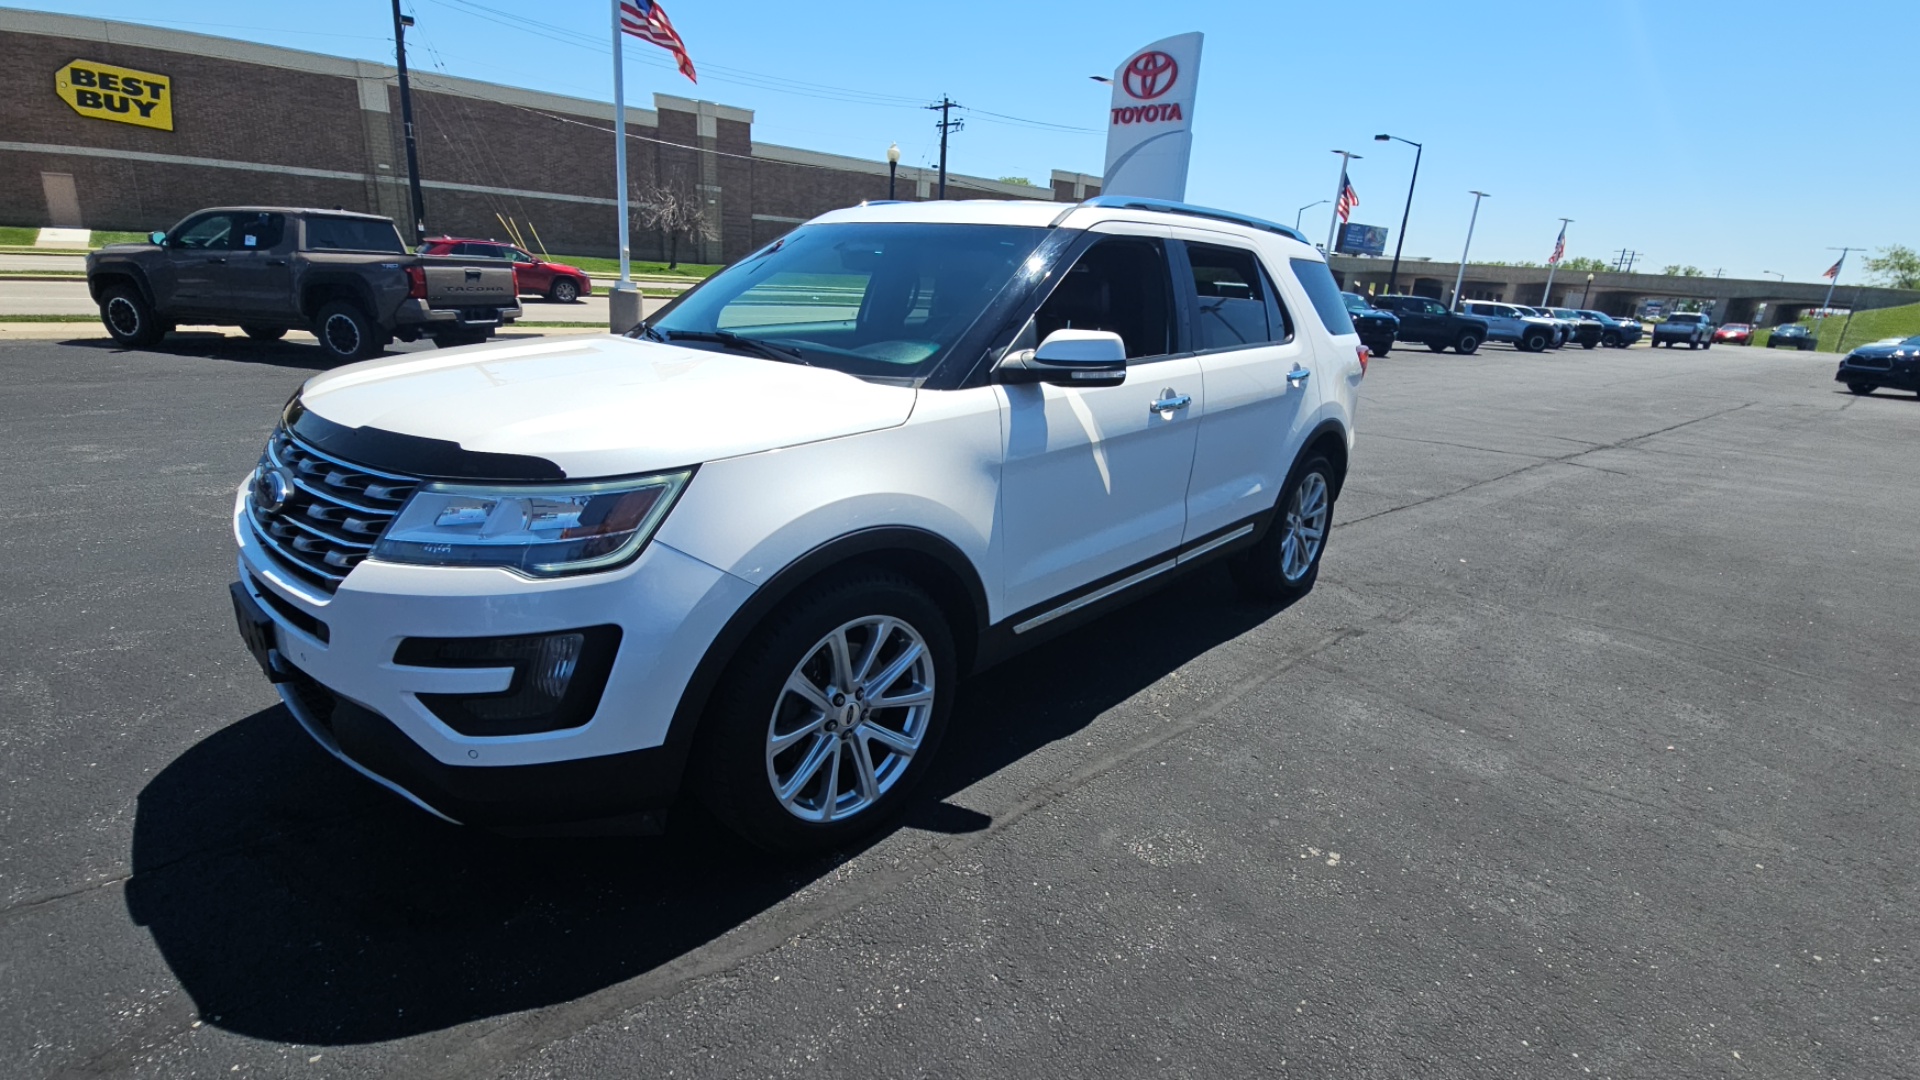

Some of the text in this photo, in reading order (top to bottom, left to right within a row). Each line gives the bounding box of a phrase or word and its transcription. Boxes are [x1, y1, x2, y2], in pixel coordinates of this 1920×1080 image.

[70, 67, 165, 100] BEST
[76, 89, 158, 118] BUY
[1111, 103, 1182, 125] TOYOTA
